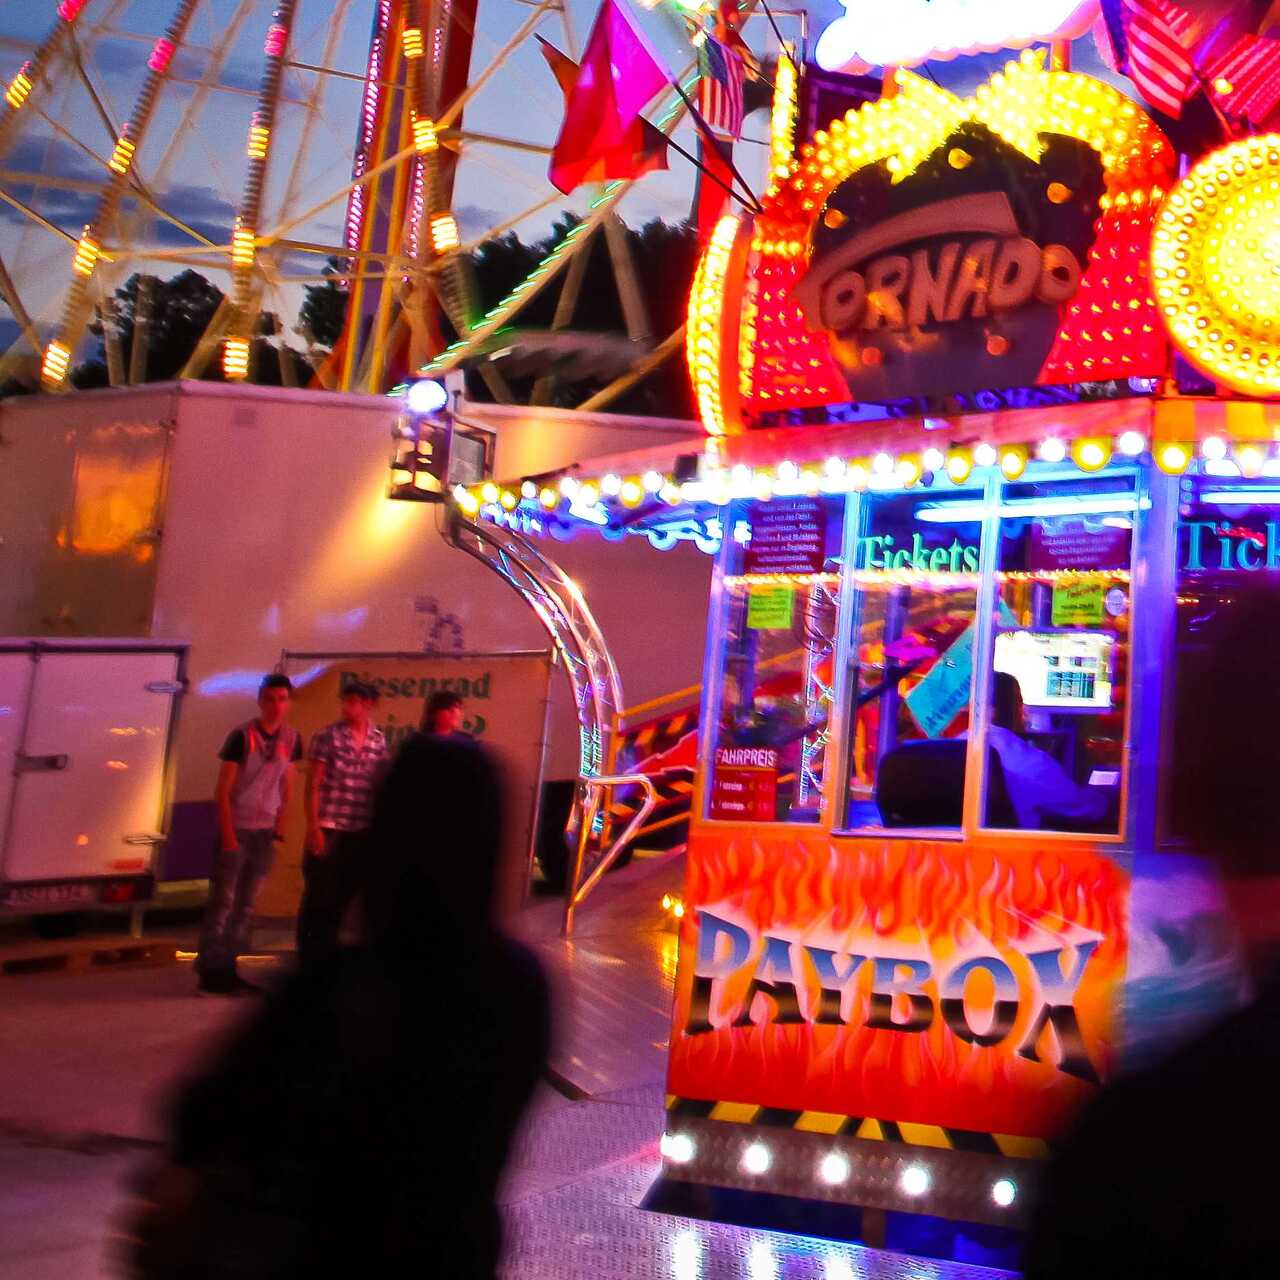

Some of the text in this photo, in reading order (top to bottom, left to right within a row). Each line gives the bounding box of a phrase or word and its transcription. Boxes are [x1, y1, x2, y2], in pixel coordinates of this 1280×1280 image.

[793, 191, 1080, 338] TORNADO
[860, 533, 980, 574] Tickets
[340, 671, 490, 698] Resenrad
[715, 748, 778, 769] FAHRPREIS
[683, 908, 1104, 1085] PAYBOX
